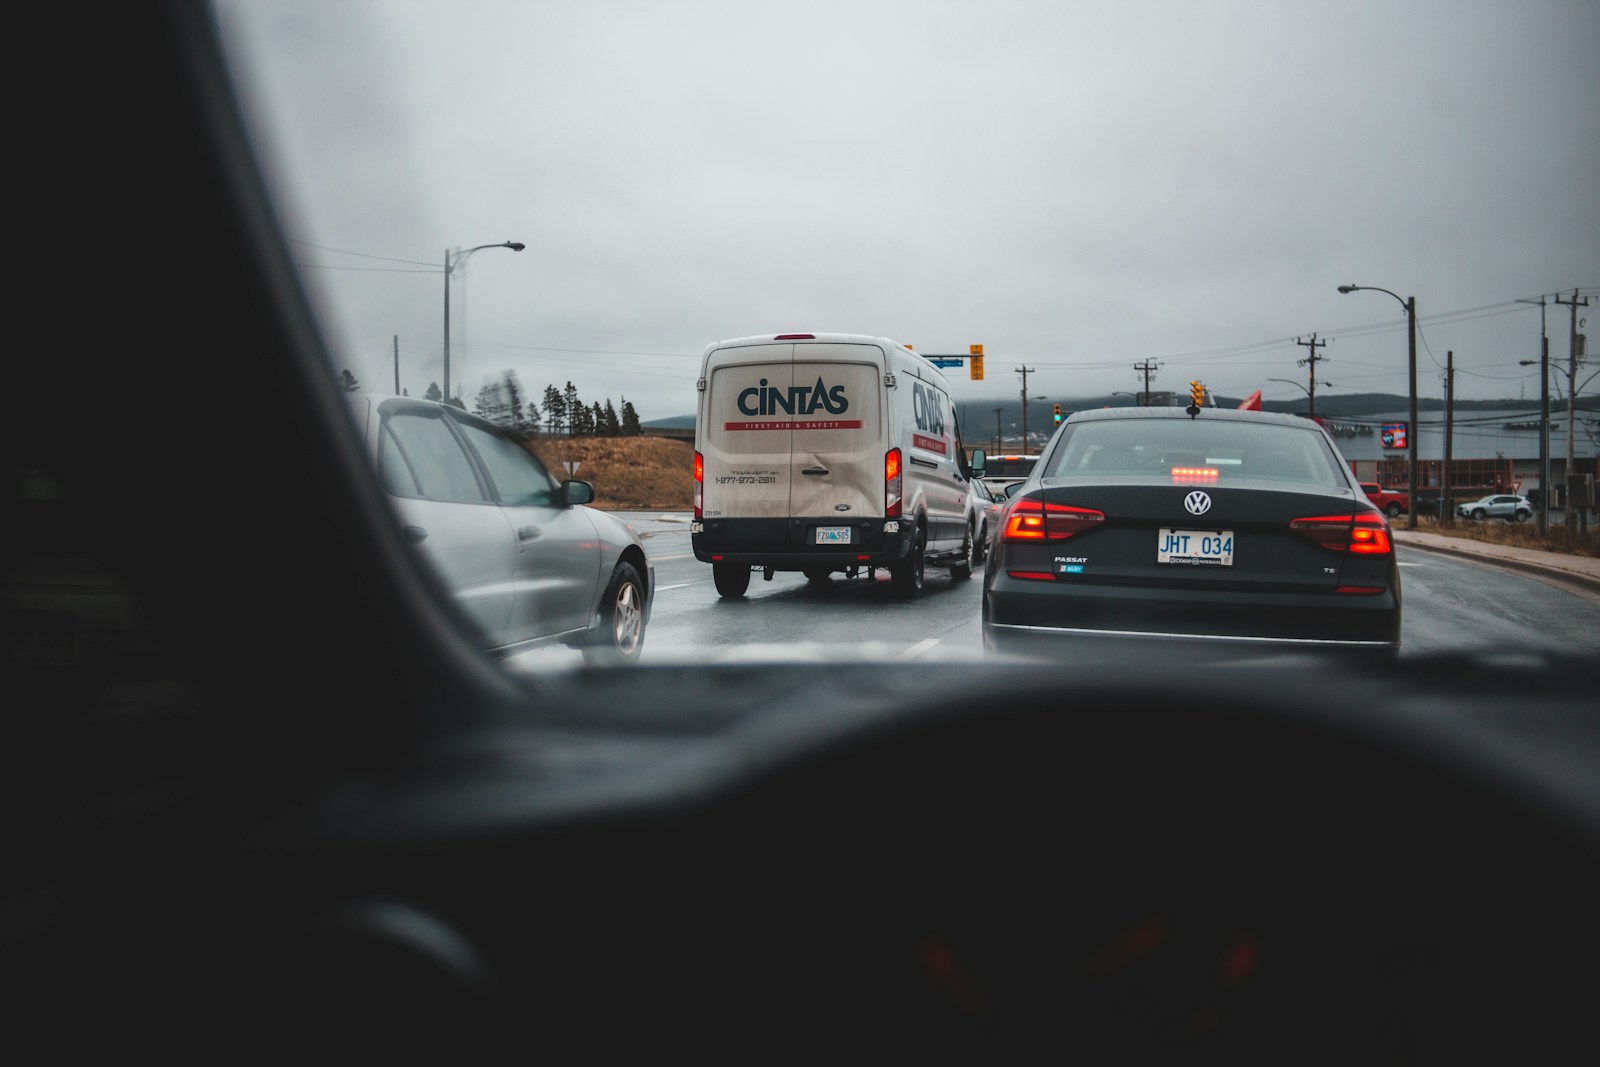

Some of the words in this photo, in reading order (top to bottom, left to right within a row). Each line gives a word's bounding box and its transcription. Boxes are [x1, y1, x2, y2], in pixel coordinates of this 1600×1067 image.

[805, 421, 840, 429] SAFETY
[1160, 535, 1191, 553] JHT
[1202, 537, 1232, 556] 034
